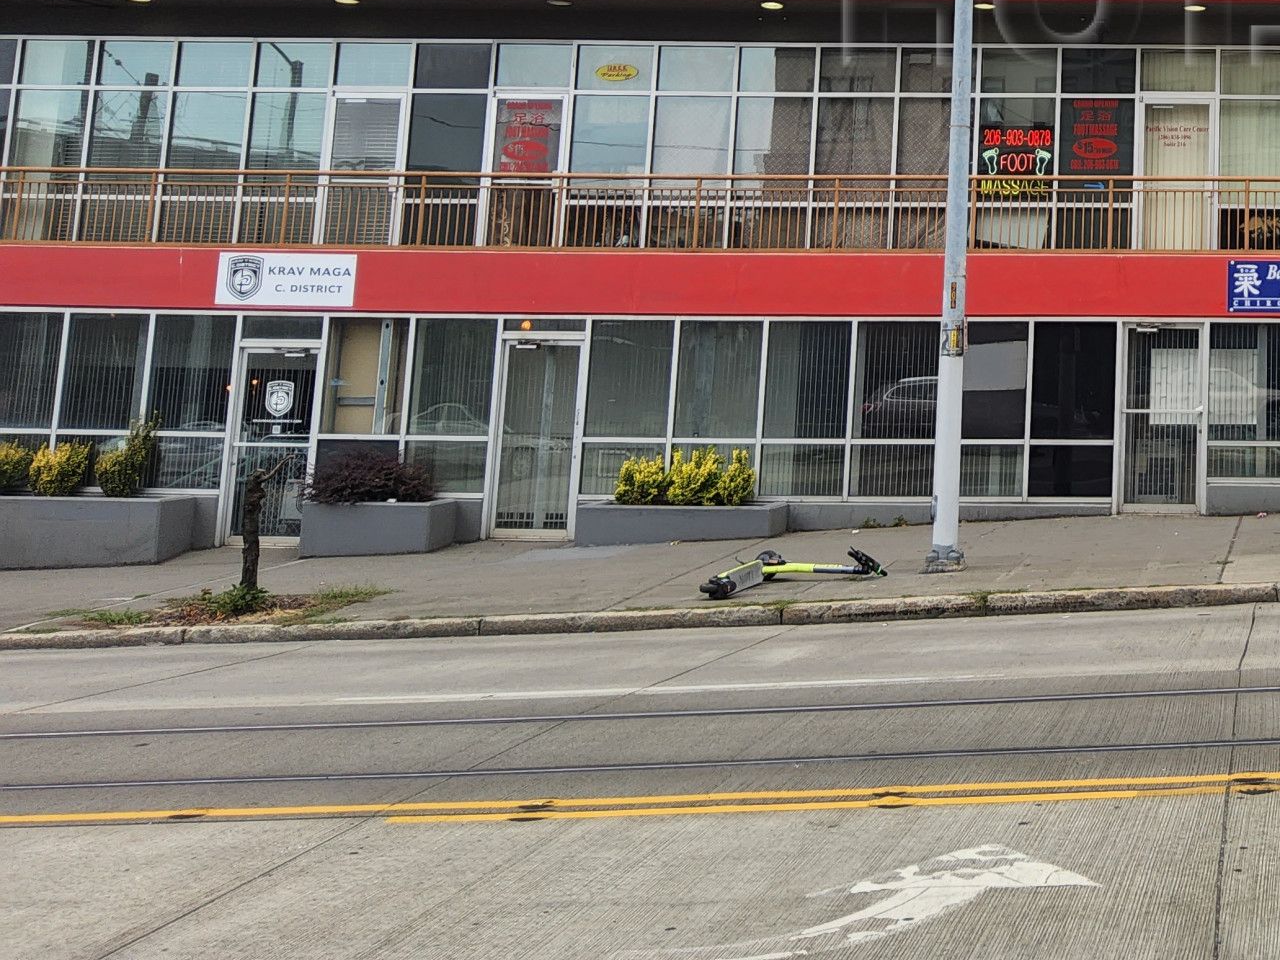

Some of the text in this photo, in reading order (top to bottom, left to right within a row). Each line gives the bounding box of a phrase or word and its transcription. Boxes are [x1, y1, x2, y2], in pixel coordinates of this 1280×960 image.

[983, 128, 1051, 147] 206-903-0878
[1000, 153, 1036, 172] FOOT
[981, 178, 1049, 195] MASSAGE
[268, 266, 352, 277] KRAV MAGA
[275, 284, 342, 294] C. DISTRICT
